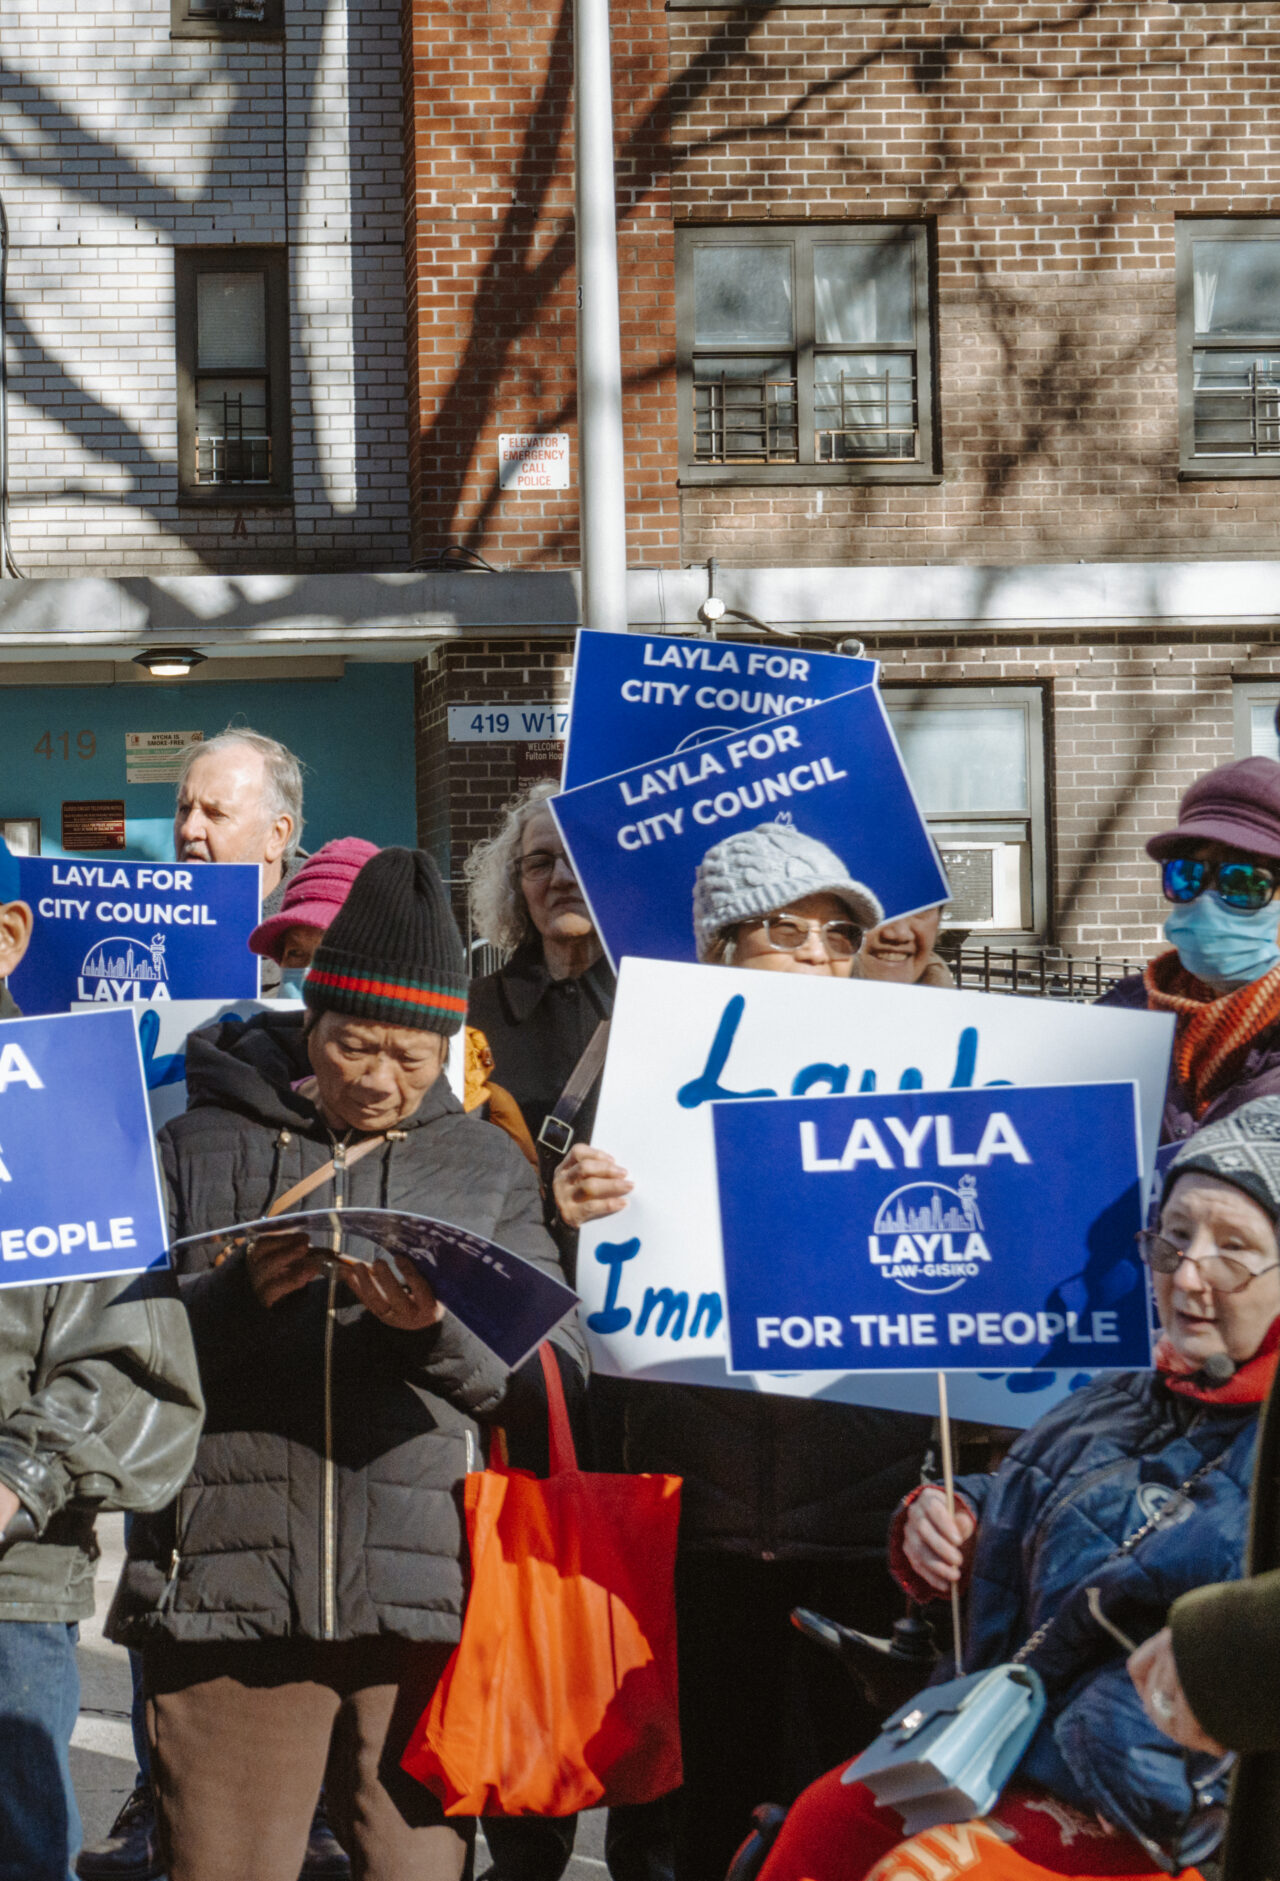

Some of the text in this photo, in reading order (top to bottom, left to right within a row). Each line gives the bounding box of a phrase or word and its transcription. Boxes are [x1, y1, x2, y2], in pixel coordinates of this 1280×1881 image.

[503, 450, 564, 460] EMERGENCY
[508, 437, 559, 448] ELEVATOR
[517, 475, 552, 486] POLICE
[522, 462, 547, 473] CALL
[643, 643, 810, 681] LAYLA FOR
[620, 680, 690, 705] CITY
[470, 713, 510, 733] 419
[34, 729, 97, 760] 419
[525, 751, 548, 760] Fulton
[527, 742, 561, 751] WELCOME
[619, 725, 802, 806] LAYLA FOR
[617, 756, 848, 850] CITY COUNCIL
[52, 865, 193, 891] LAYLA FOR
[38, 898, 217, 925] CITY COUNCIL
[77, 976, 172, 1002] LAYLA
[799, 1112, 1033, 1172] LAYLA
[868, 1232, 992, 1264] LAYLA
[881, 1263, 979, 1279] LAW-GISIKO
[757, 1310, 1120, 1348] FOR THE PEOPLE
